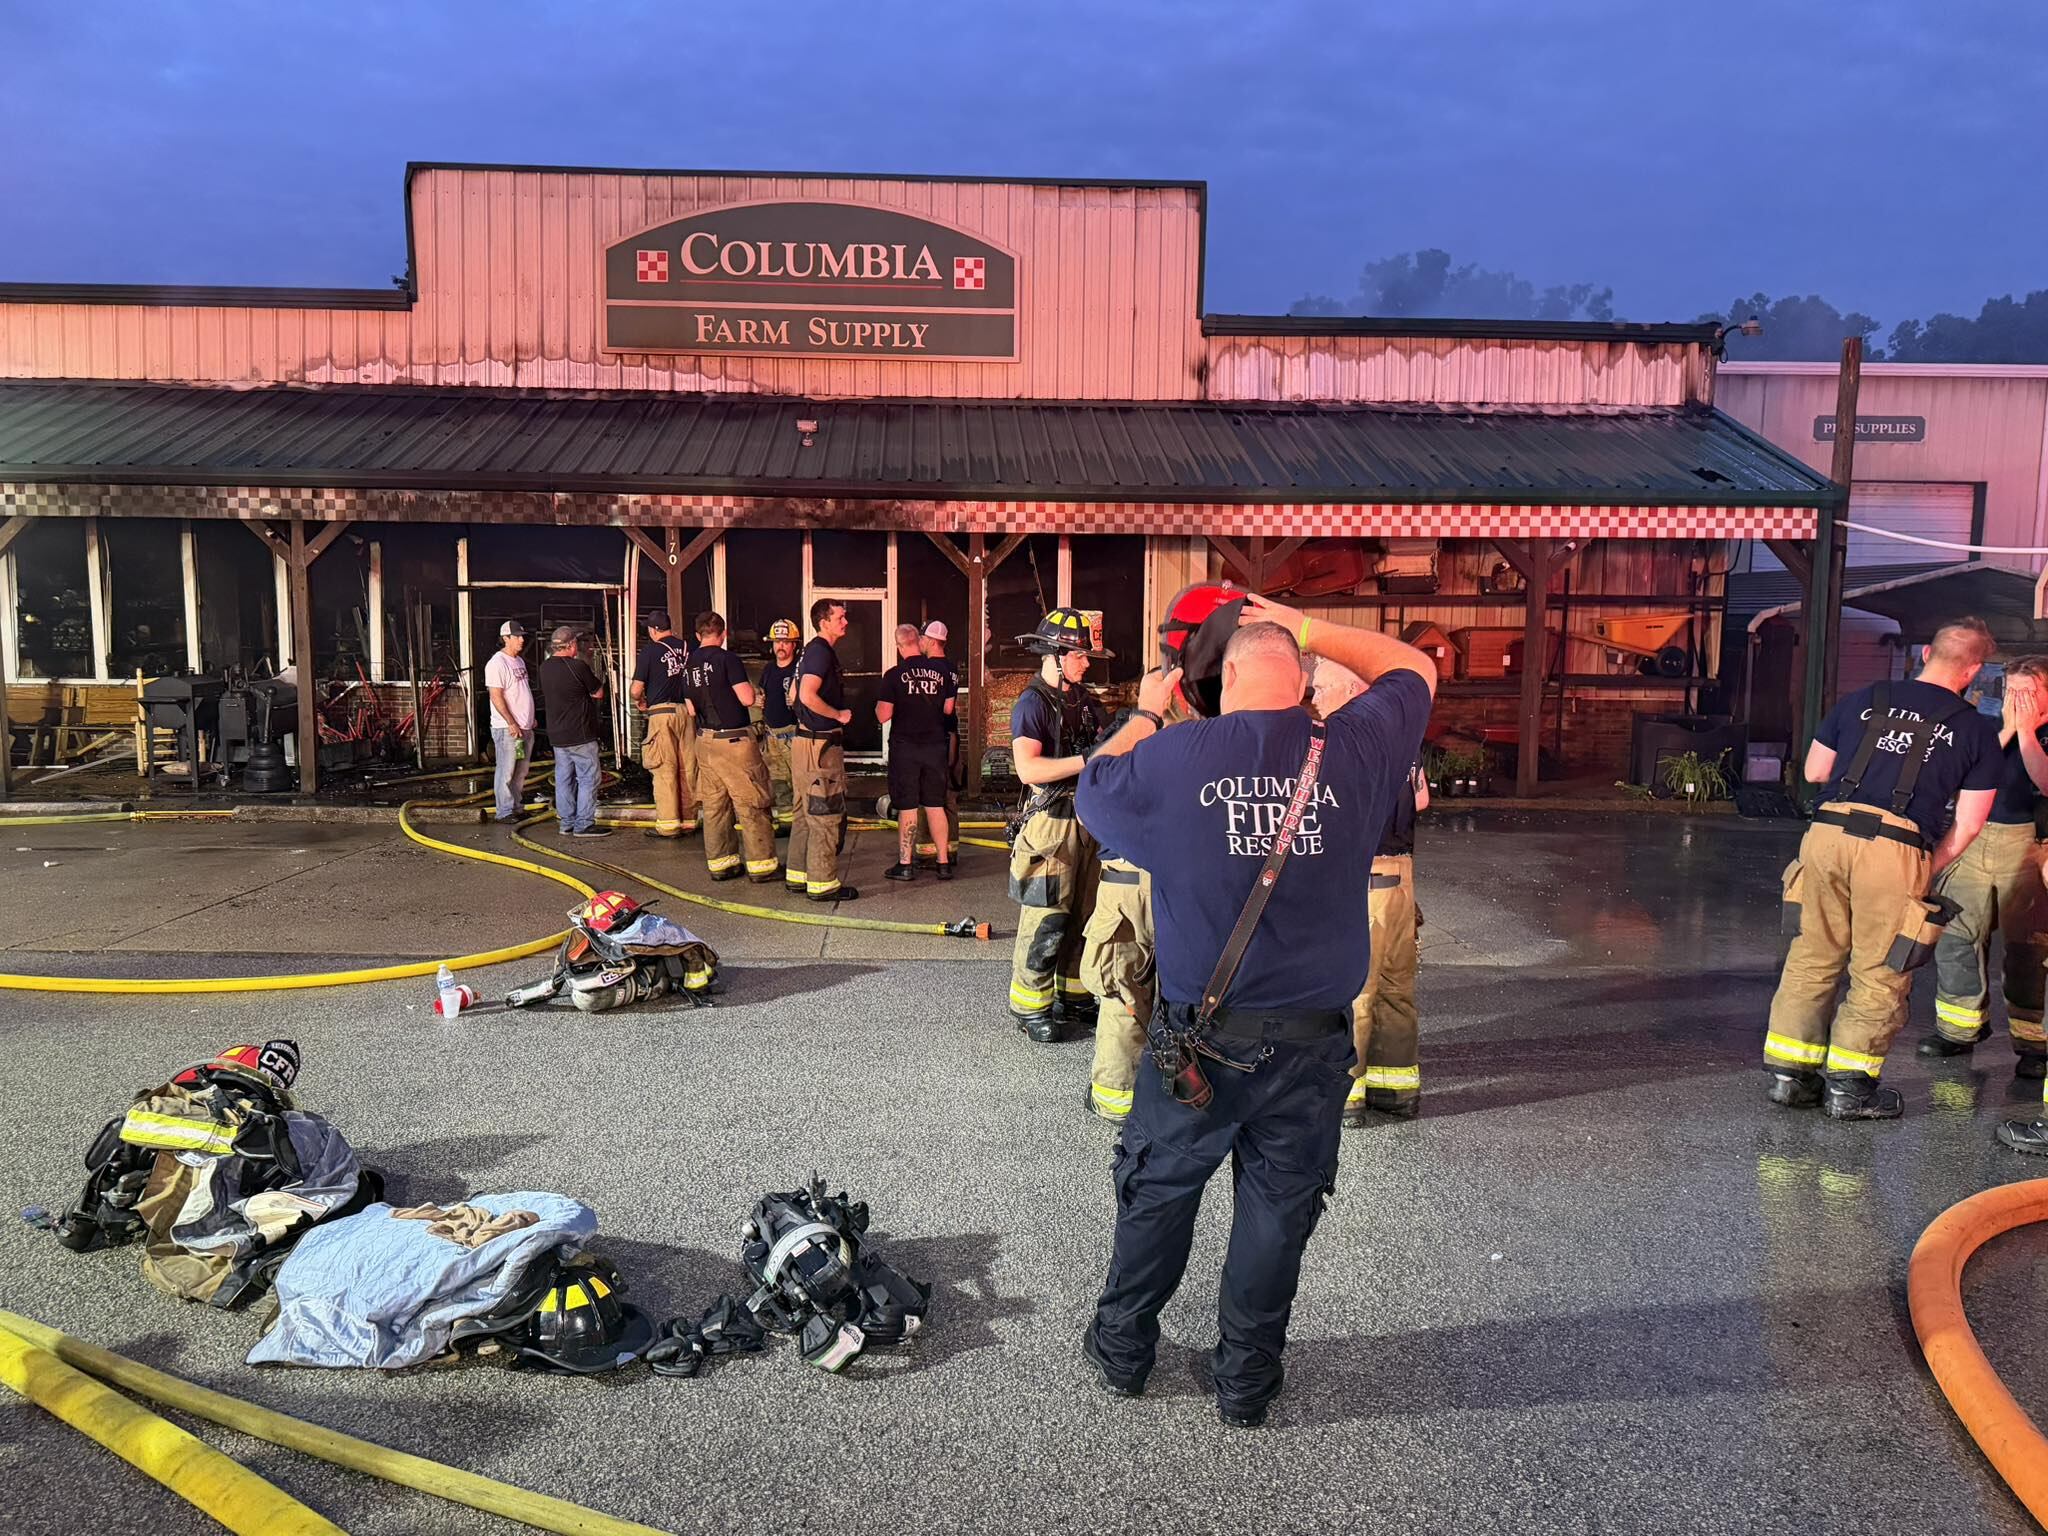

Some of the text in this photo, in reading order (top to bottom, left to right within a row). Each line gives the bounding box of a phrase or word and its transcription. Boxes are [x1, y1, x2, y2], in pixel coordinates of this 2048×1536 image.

[680, 232, 943, 280] COLUMBIA
[694, 314, 929, 349] FARM SUPPLY
[1855, 423, 1917, 434] SUPPLIES
[1200, 776, 1340, 808] COLUMIA
[1275, 736, 1325, 855] WEATHERLY
[1223, 800, 1322, 836] FIRE
[1226, 834, 1325, 857] RESUE
[260, 1050, 296, 1084] CFR
